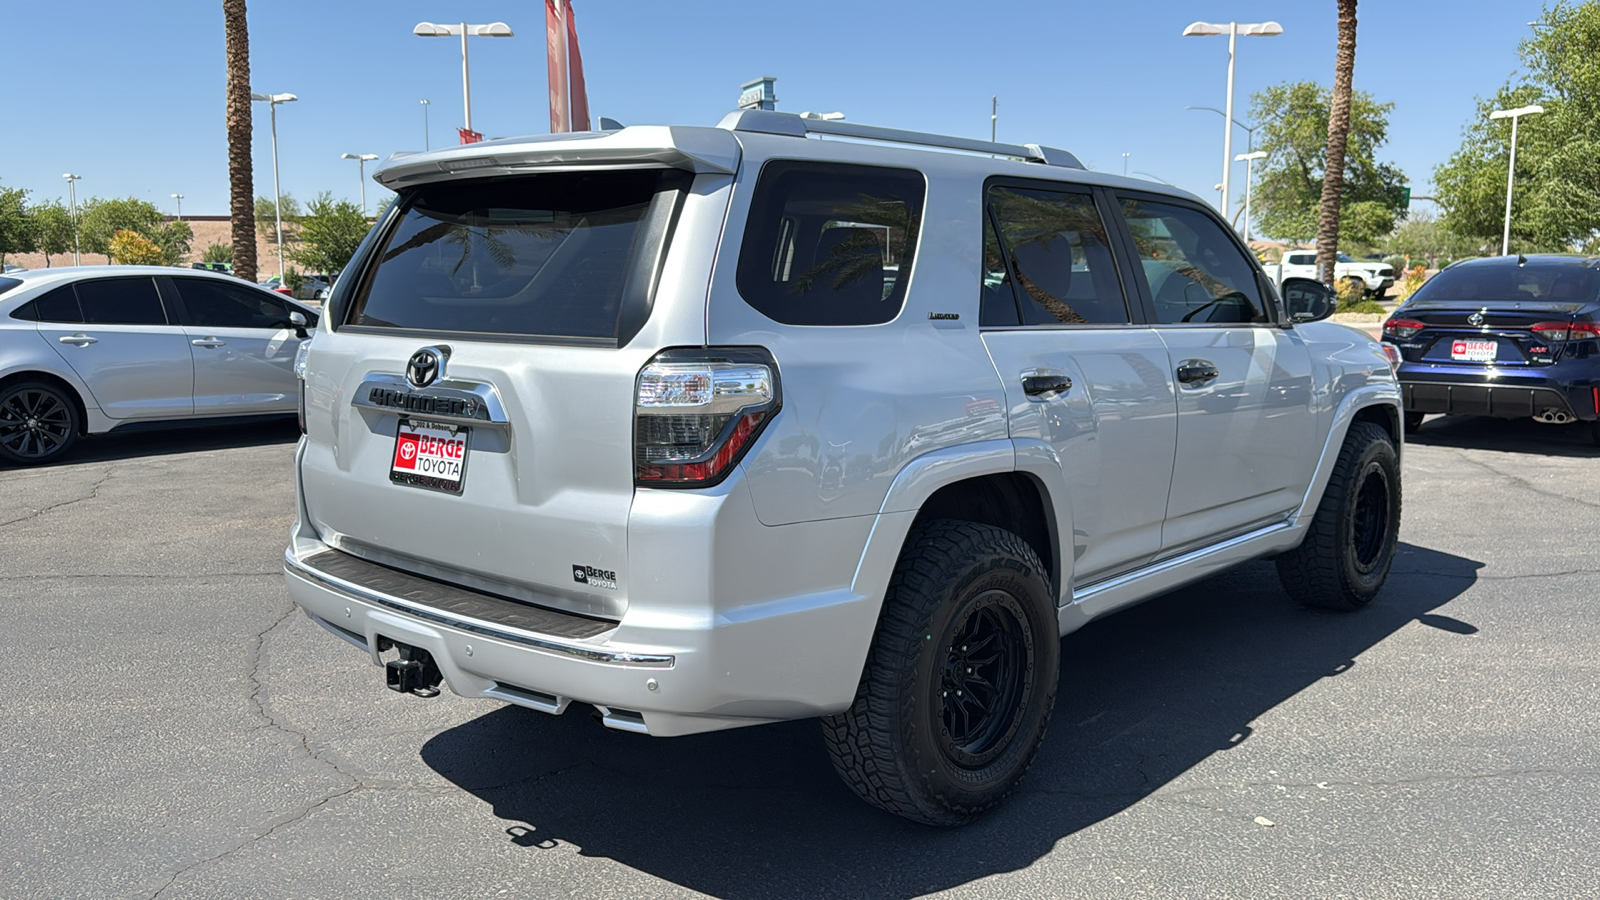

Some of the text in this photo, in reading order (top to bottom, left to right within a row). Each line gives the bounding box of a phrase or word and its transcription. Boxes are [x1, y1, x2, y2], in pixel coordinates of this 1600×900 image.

[1467, 342, 1495, 351] BERGE
[419, 434, 464, 459] BERGE
[417, 457, 460, 477] TOYOTA
[586, 565, 616, 581] BERGE
[587, 577, 618, 590] TOYOTA
